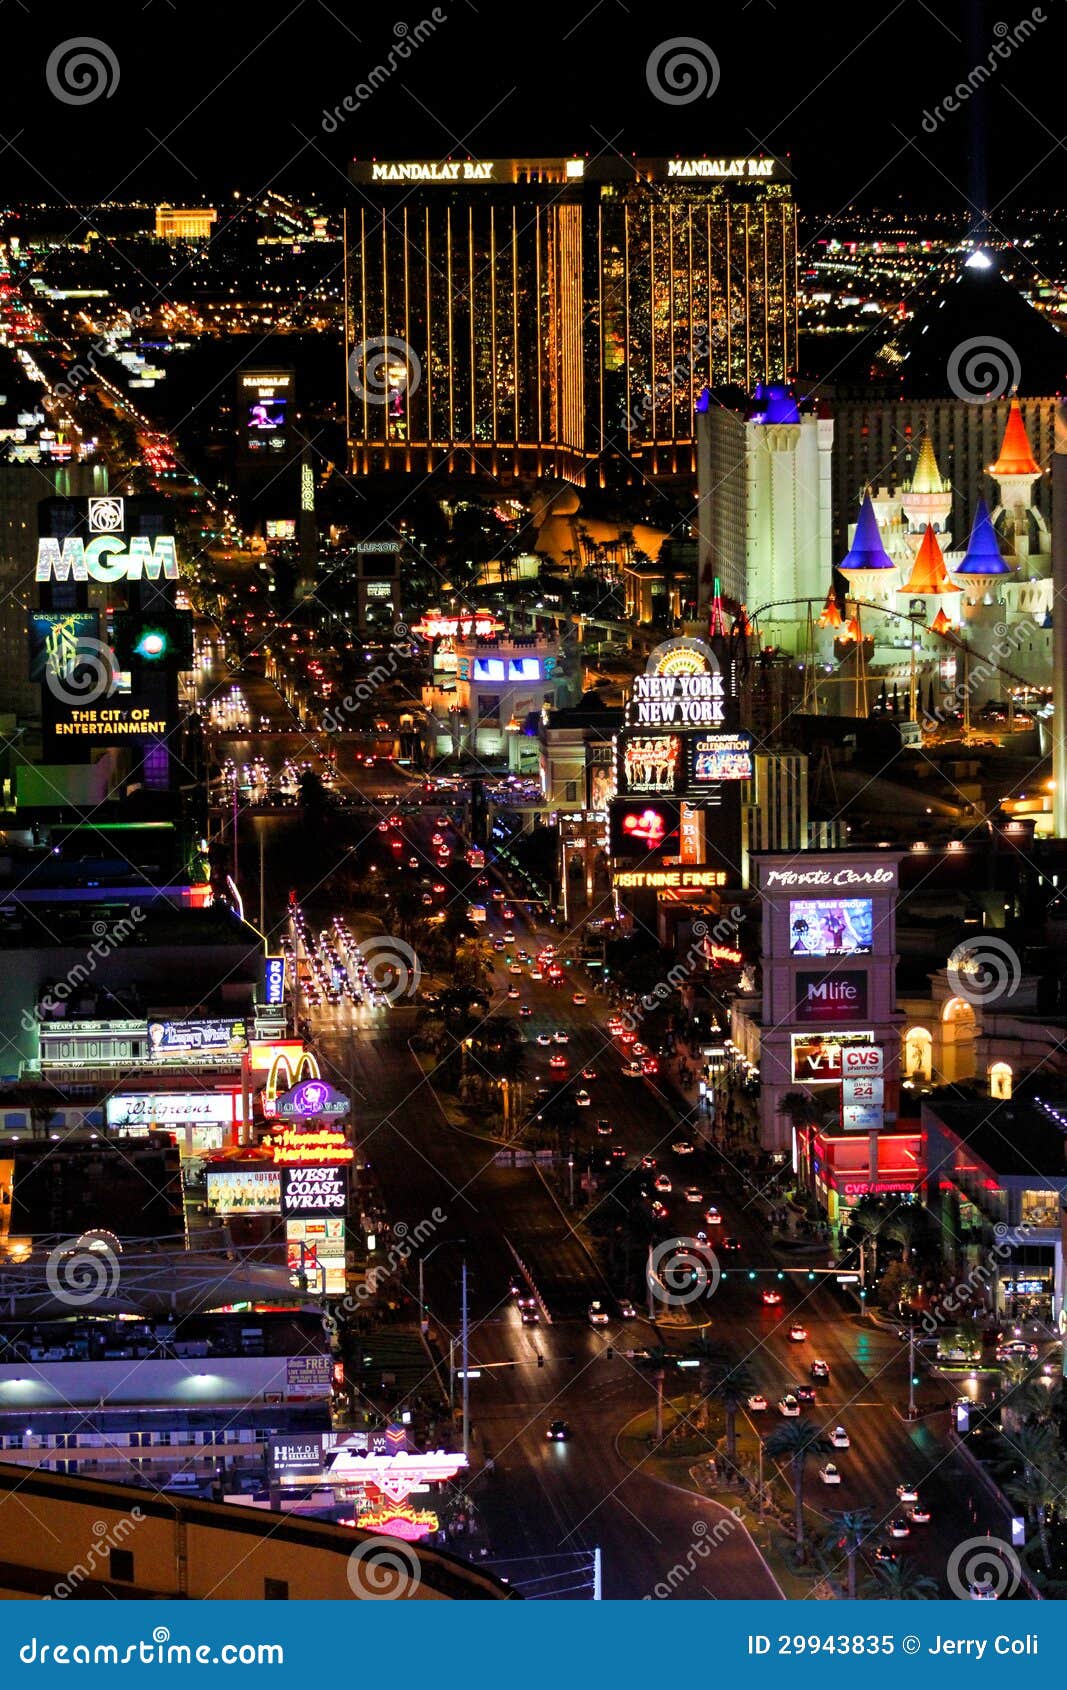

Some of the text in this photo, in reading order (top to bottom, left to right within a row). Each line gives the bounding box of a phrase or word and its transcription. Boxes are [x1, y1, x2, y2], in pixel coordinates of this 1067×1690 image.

[372, 163, 494, 180] MANDALAY BAY
[668, 159, 775, 177] MANDALAY BAY
[302, 464, 314, 511] LUXOR
[356, 543, 400, 553] LUXOR
[35, 535, 180, 583] MGM
[638, 677, 725, 697] NEW YORK
[71, 709, 150, 722] THE CITY OF
[638, 701, 725, 722] NEW YORK
[55, 721, 167, 735] ENTERTAINMENT
[613, 873, 645, 886] VISIT
[646, 873, 680, 886] NINE
[683, 873, 716, 886] FINE
[767, 868, 893, 886] Monte Carlo
[847, 1052, 879, 1066] CVS
[854, 1087, 873, 1096] 24
[125, 1101, 212, 1119] Walgreens
[289, 1168, 338, 1182] WEST
[286, 1182, 343, 1195] COAST
[845, 1184, 869, 1194] CVS
[875, 1183, 915, 1193] pharmacy
[284, 1194, 345, 1208] WRAPS
[306, 1358, 330, 1368] FREE
[288, 1445, 319, 1453] HYDE
